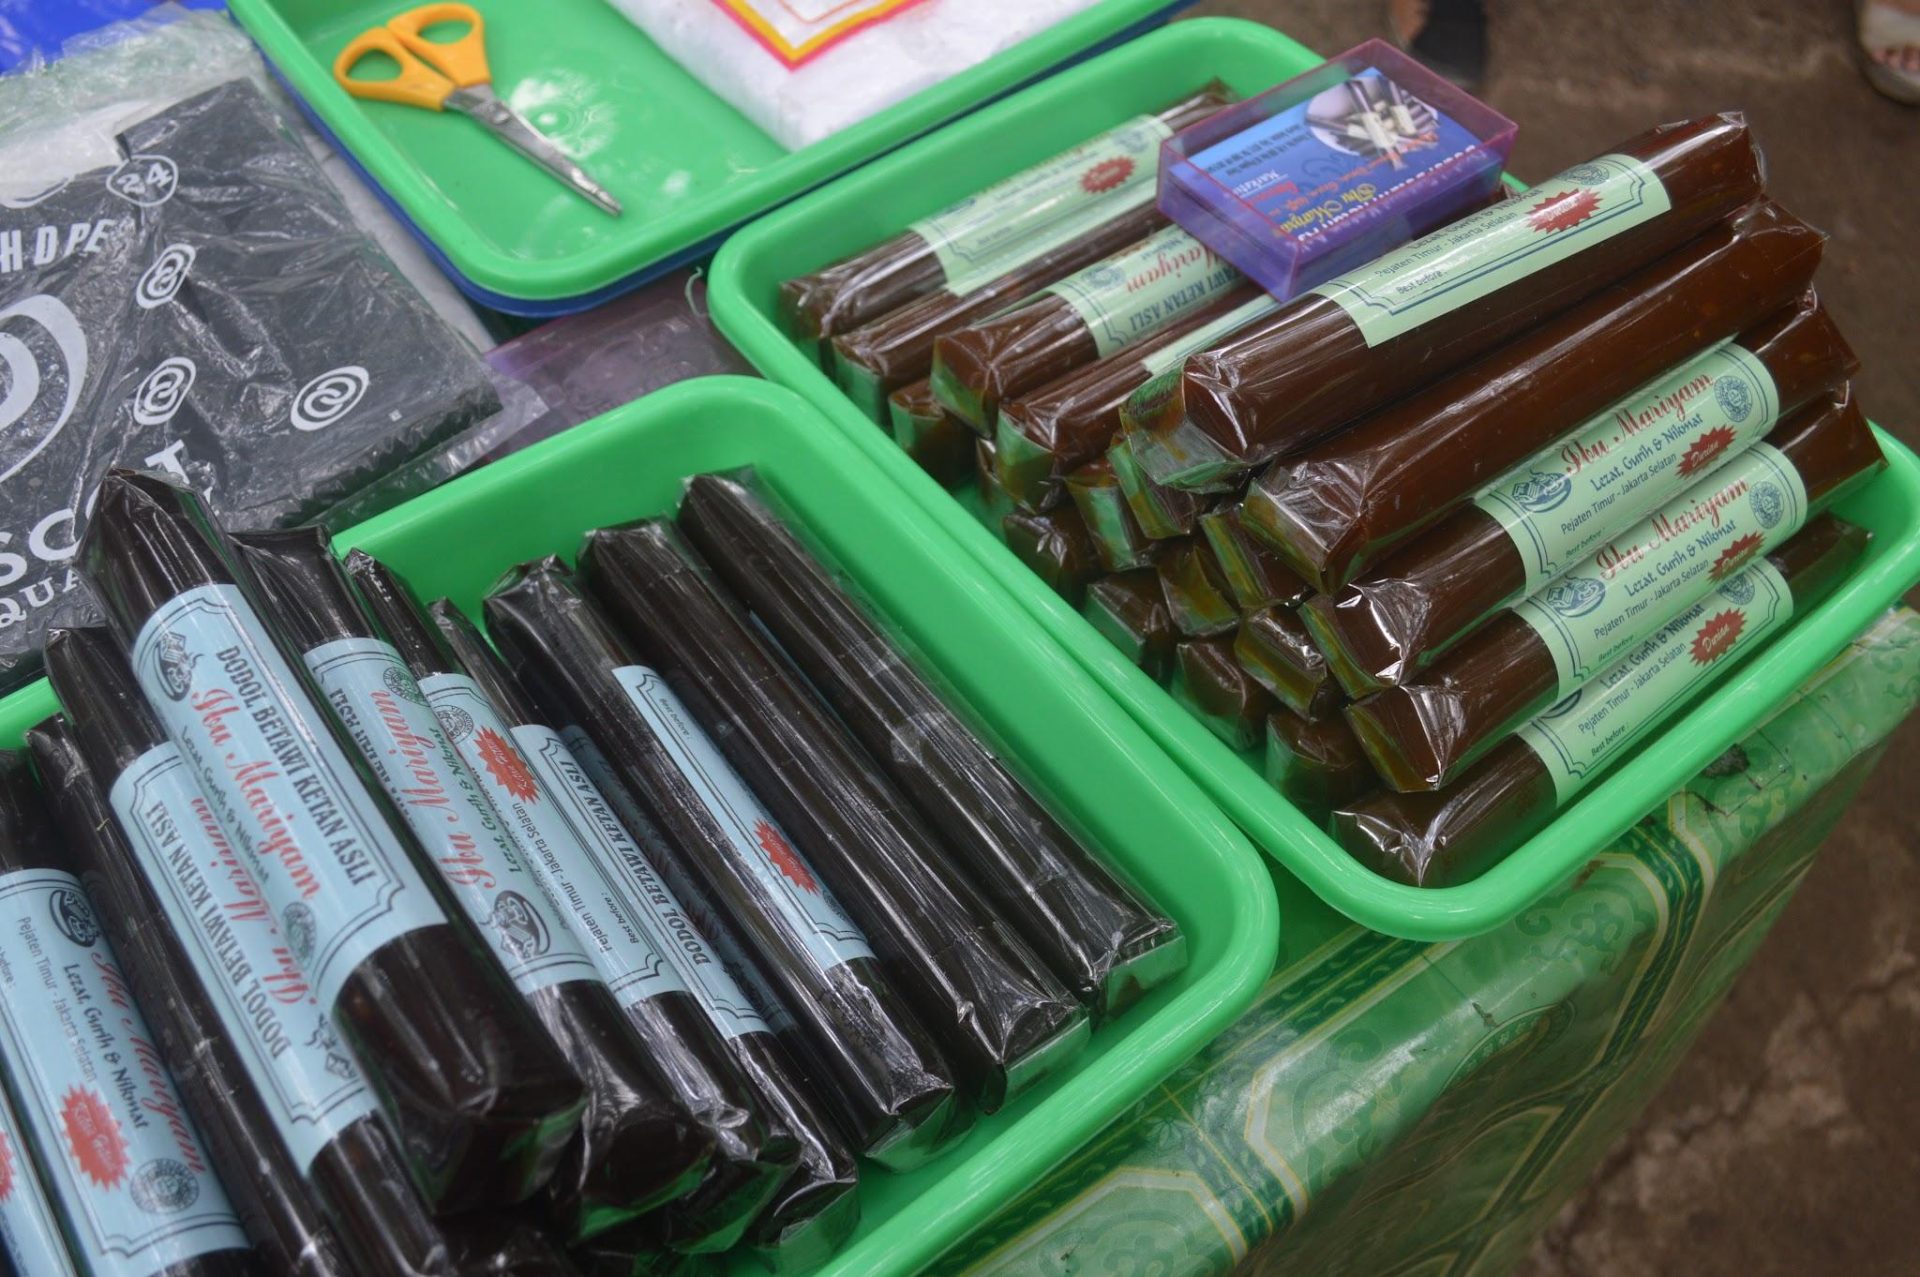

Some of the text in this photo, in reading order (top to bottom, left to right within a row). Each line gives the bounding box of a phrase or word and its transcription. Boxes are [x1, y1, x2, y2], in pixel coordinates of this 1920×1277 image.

[117, 163, 172, 194] 24
[1126, 302, 1164, 331] ASLI
[1561, 438, 1610, 472] Ibu
[1613, 371, 1714, 442] Mariyam
[1621, 444, 1653, 470] Gurih
[1651, 437, 1664, 451] &
[1661, 412, 1703, 443] Nikmat
[1561, 507, 1592, 534] Pejaten
[1591, 492, 1617, 513] Timur
[1620, 470, 1649, 495] Jakarta
[1648, 451, 1677, 476] Selatan
[1593, 543, 1645, 577] Ibu
[1649, 476, 1750, 549] Mariyam
[1654, 550, 1686, 576] Gurih
[1684, 542, 1698, 557] &
[1696, 520, 1736, 550] Nikmat
[1595, 613, 1625, 639] Pejaten
[1624, 597, 1649, 618] Timur
[1653, 575, 1682, 600] Jakarta
[1681, 557, 1709, 581] Selatan
[1578, 707, 1610, 736] Pejaten
[1606, 688, 1630, 710] Timur
[1633, 663, 1661, 689] Jakarta
[1657, 641, 1686, 667] Selatan
[426, 724, 465, 778] Nikmat
[669, 711, 691, 737] before
[1605, 725, 1626, 746] before
[215, 644, 267, 708] DODOL
[250, 701, 309, 779] BETAWI
[292, 770, 348, 841] KETAN
[328, 830, 377, 888] ASLI
[367, 686, 458, 822] Mariyam
[191, 686, 240, 747] Ibu
[224, 753, 322, 899] Mariyam
[458, 776, 473, 793] &
[466, 791, 498, 833] Gurih
[509, 800, 539, 840] Selatan
[436, 826, 496, 885] Ibu
[532, 837, 563, 875] Jakarta
[559, 758, 710, 965] DODOL BETAWI KETAN ASLI
[559, 879, 587, 913] Timur
[603, 894, 626, 926] before
[142, 799, 294, 1059] DODOL BETAWI KETAN ASLI
[579, 911, 612, 953] Pejaten
[622, 924, 639, 945] Best
[17, 915, 43, 957] Pejaten
[36, 956, 58, 990] Timur
[52, 996, 78, 1039] Jakarta
[70, 1037, 98, 1083] Selatan
[63, 962, 149, 1129] Lezat, Gurih & Nikmat
[92, 952, 127, 1011] Ibu
[122, 1018, 206, 1174] Mariyam
